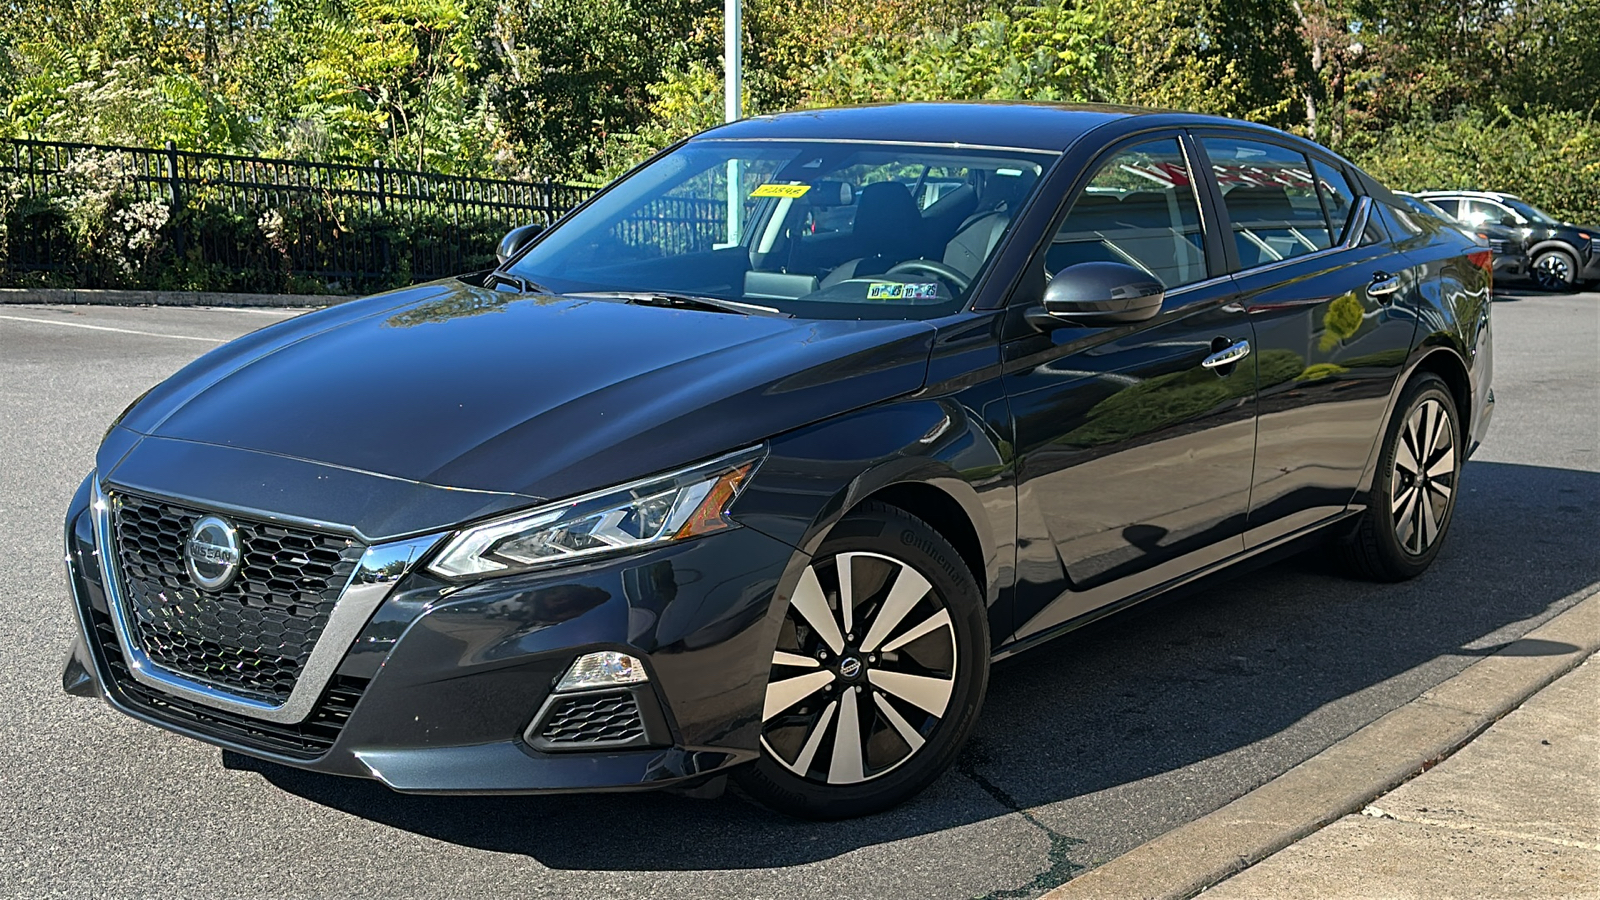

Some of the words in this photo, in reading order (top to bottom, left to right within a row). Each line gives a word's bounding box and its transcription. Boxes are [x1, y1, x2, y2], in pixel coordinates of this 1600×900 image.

[871, 287, 880, 297] 10
[905, 287, 914, 297] 10
[190, 543, 232, 562] NISSAN
